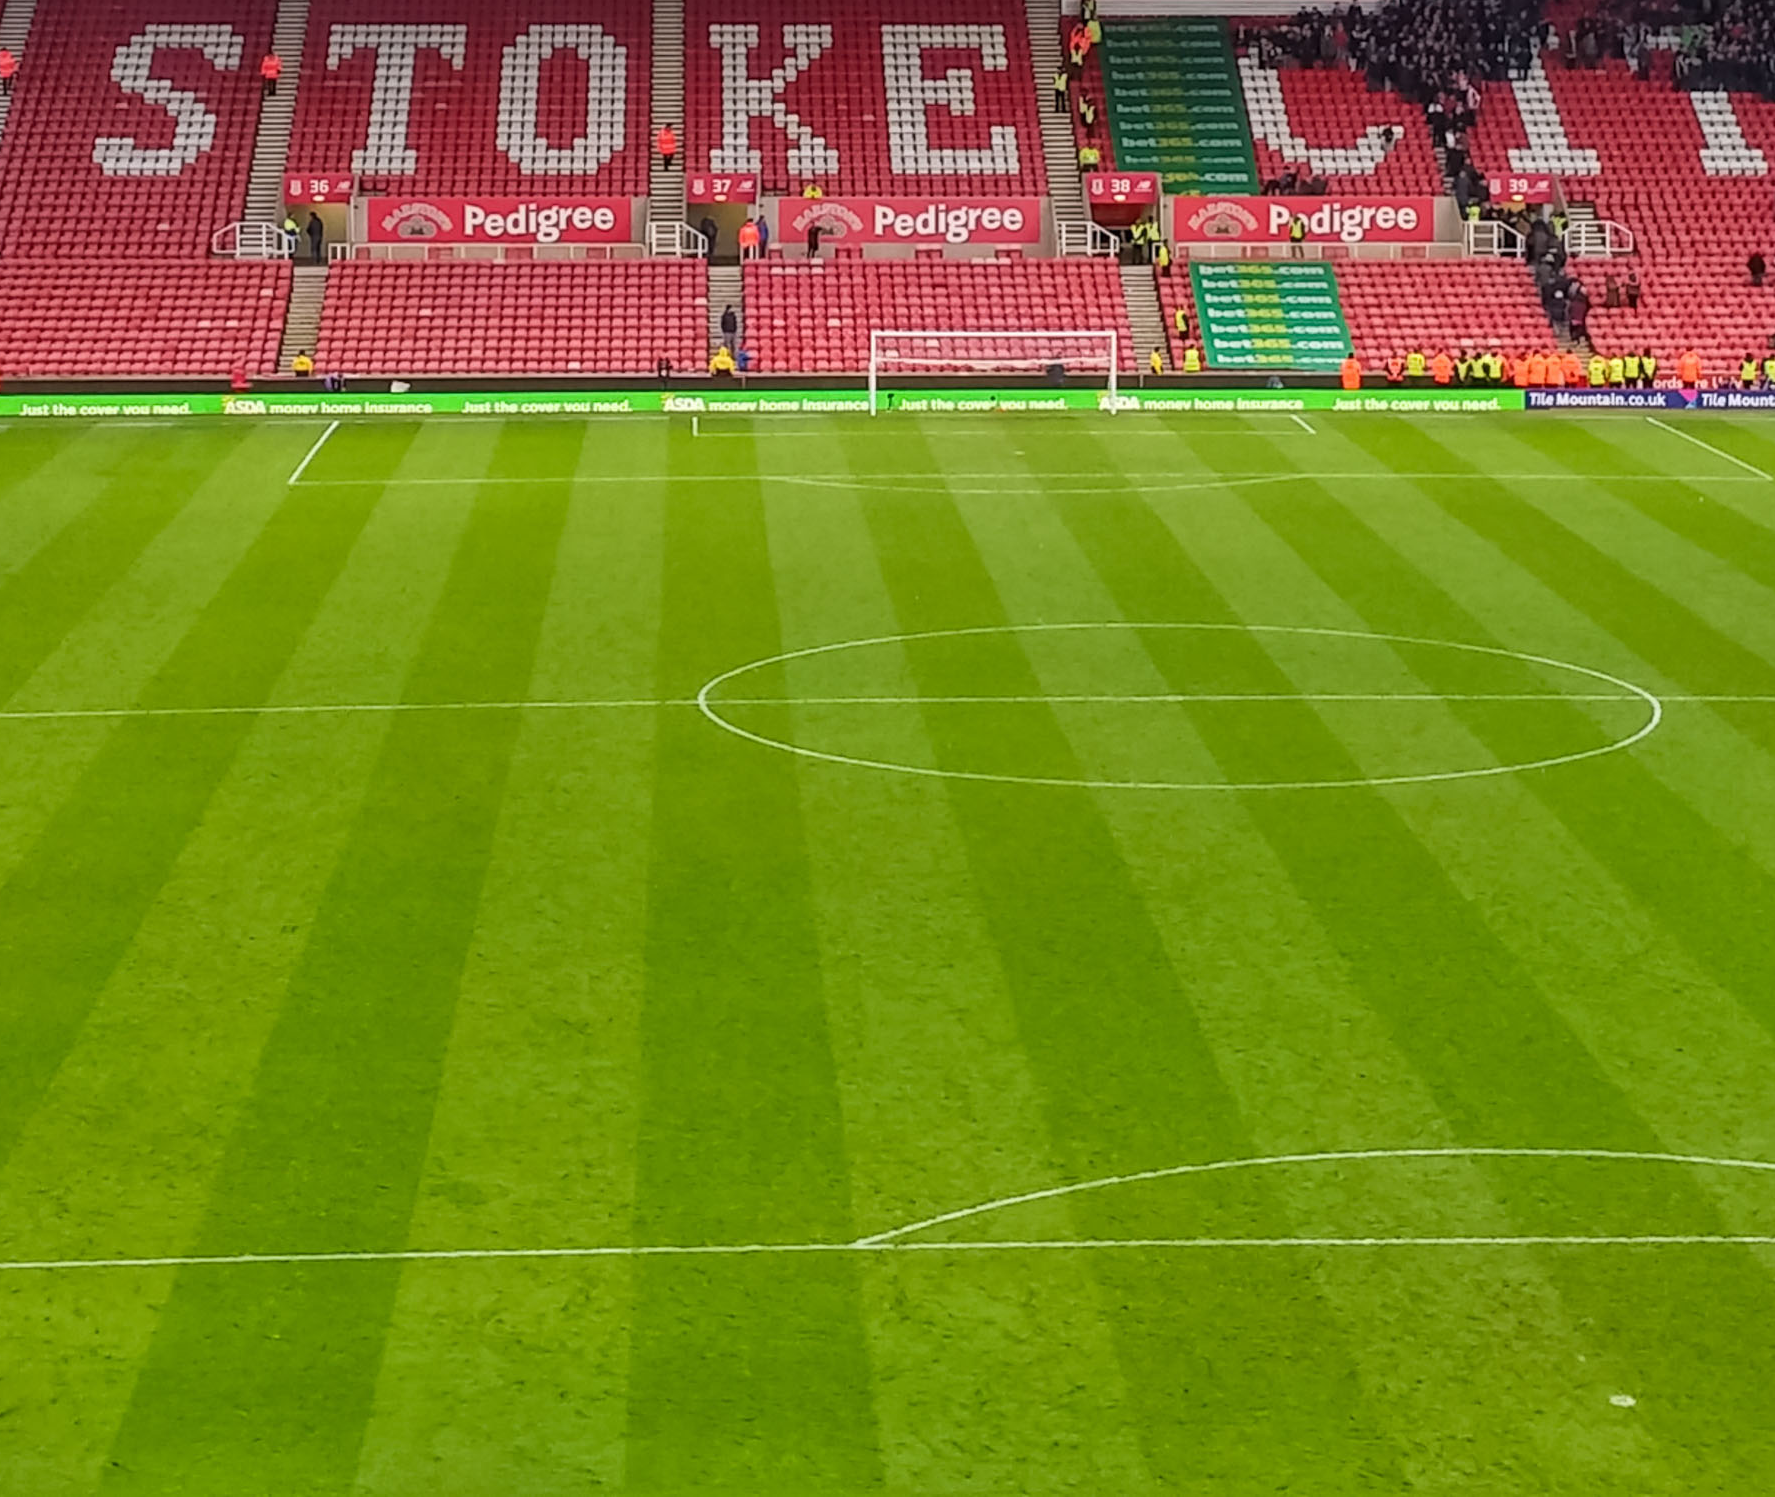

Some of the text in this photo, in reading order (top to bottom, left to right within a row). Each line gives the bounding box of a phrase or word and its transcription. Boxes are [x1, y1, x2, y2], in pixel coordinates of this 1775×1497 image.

[92, 23, 1021, 177] STOKE
[309, 179, 330, 194] 36
[712, 179, 732, 193] 37
[1111, 179, 1131, 194] 38
[1509, 178, 1528, 193] 39
[463, 203, 616, 243] Pedigree
[874, 203, 1024, 244] Pedigree
[462, 400, 633, 414] Just the cover you need.
[663, 397, 869, 412] ASDA money home insurance
[899, 399, 927, 411] Just
[931, 398, 954, 411] the
[999, 399, 1027, 411] you
[1028, 398, 1069, 410] need.
[1143, 399, 1192, 411] money
[1194, 397, 1235, 410] home
[1236, 398, 1304, 410] insurance
[1332, 398, 1501, 411] Just the cover you need.
[1529, 392, 1666, 407] Tile Mountain.co.uk
[1701, 394, 1726, 407] Tile
[20, 402, 192, 417] Just the cover you need.
[224, 400, 433, 415] ASDA money home insurance
